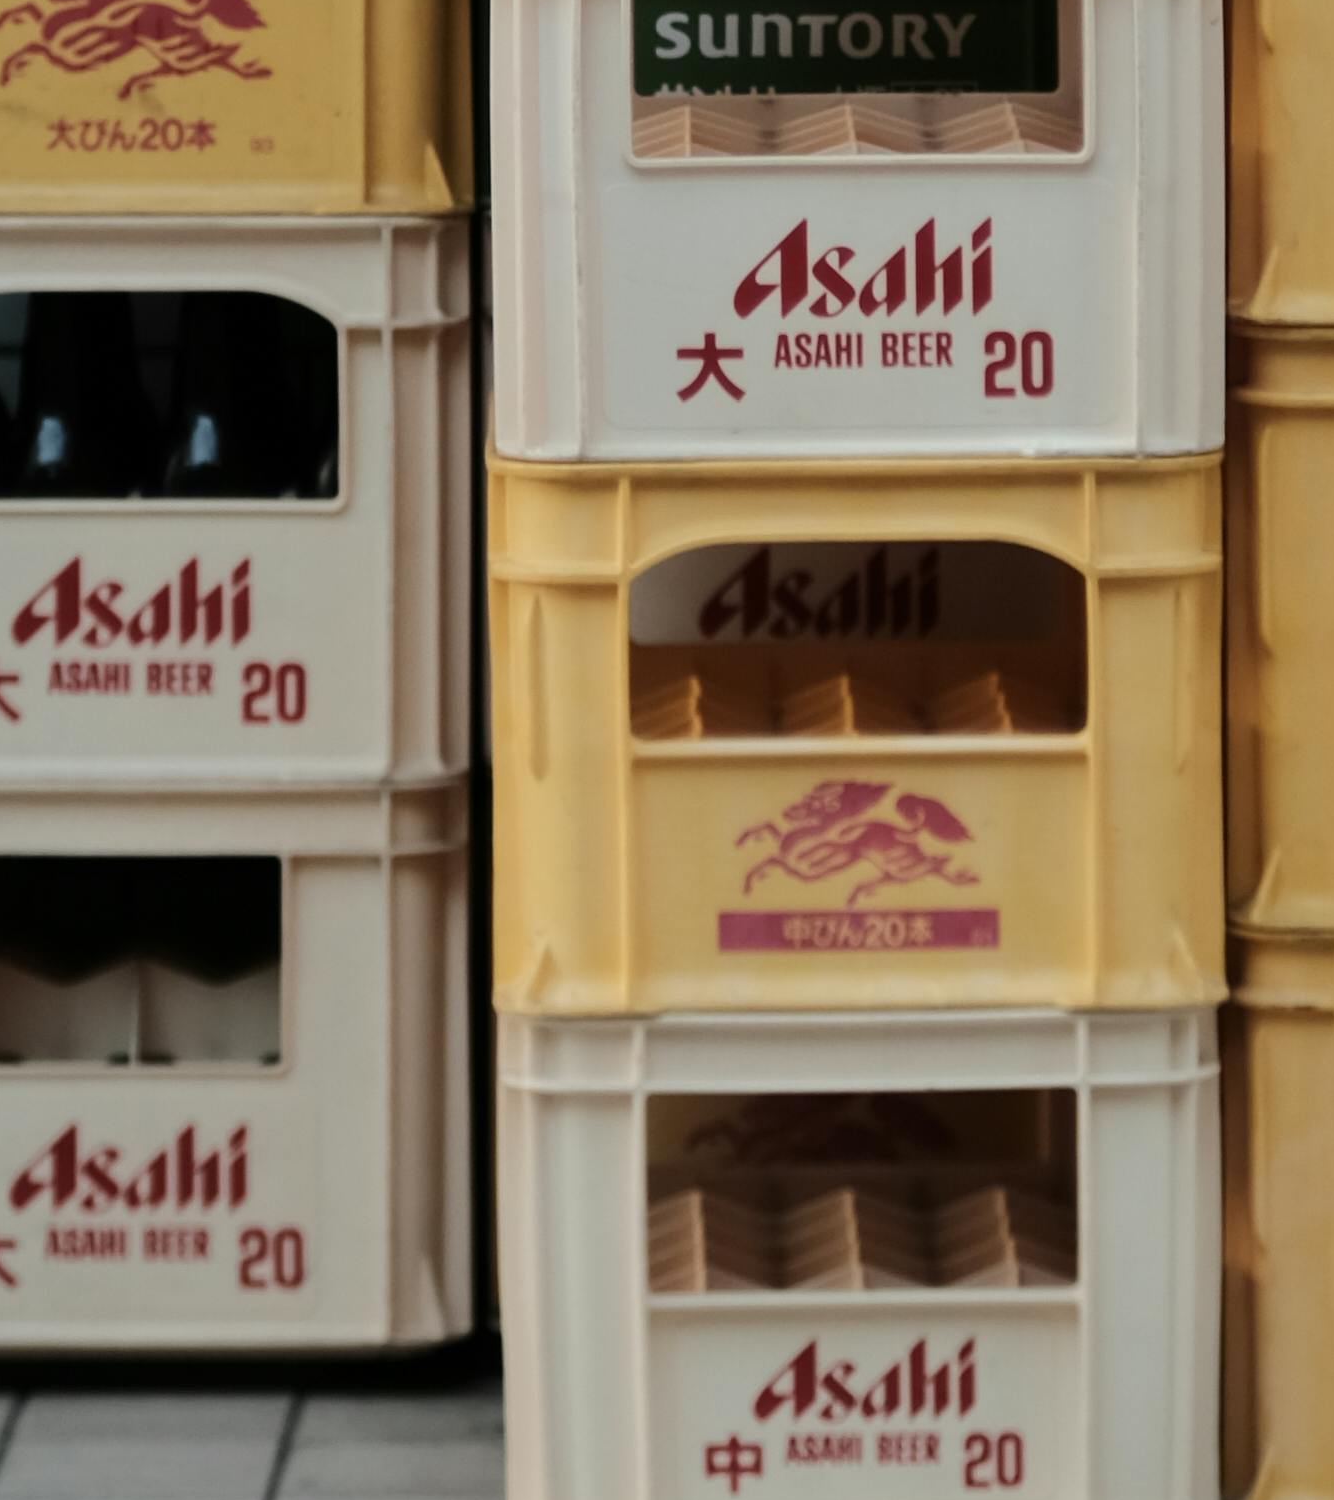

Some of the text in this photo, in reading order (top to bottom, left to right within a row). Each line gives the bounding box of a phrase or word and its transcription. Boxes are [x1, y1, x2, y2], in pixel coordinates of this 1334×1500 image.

[46, 116, 217, 152] 大びん20本
[733, 216, 993, 320] Asahi
[676, 330, 1055, 402] 大 ASAHI BEER 20
[11, 554, 251, 649] Asahi
[698, 543, 941, 641] Asahi
[48, 660, 132, 694] ASAHI
[146, 660, 214, 695] BEER
[241, 662, 307, 724] 20
[8, 1121, 248, 1212] Asahi
[45, 1228, 127, 1261] ASAHI
[141, 1228, 210, 1261] BEER
[238, 1228, 305, 1290] 20
[753, 1336, 976, 1422] Asahi
[704, 1432, 1024, 1496] 中 ASAHI BEER 20
